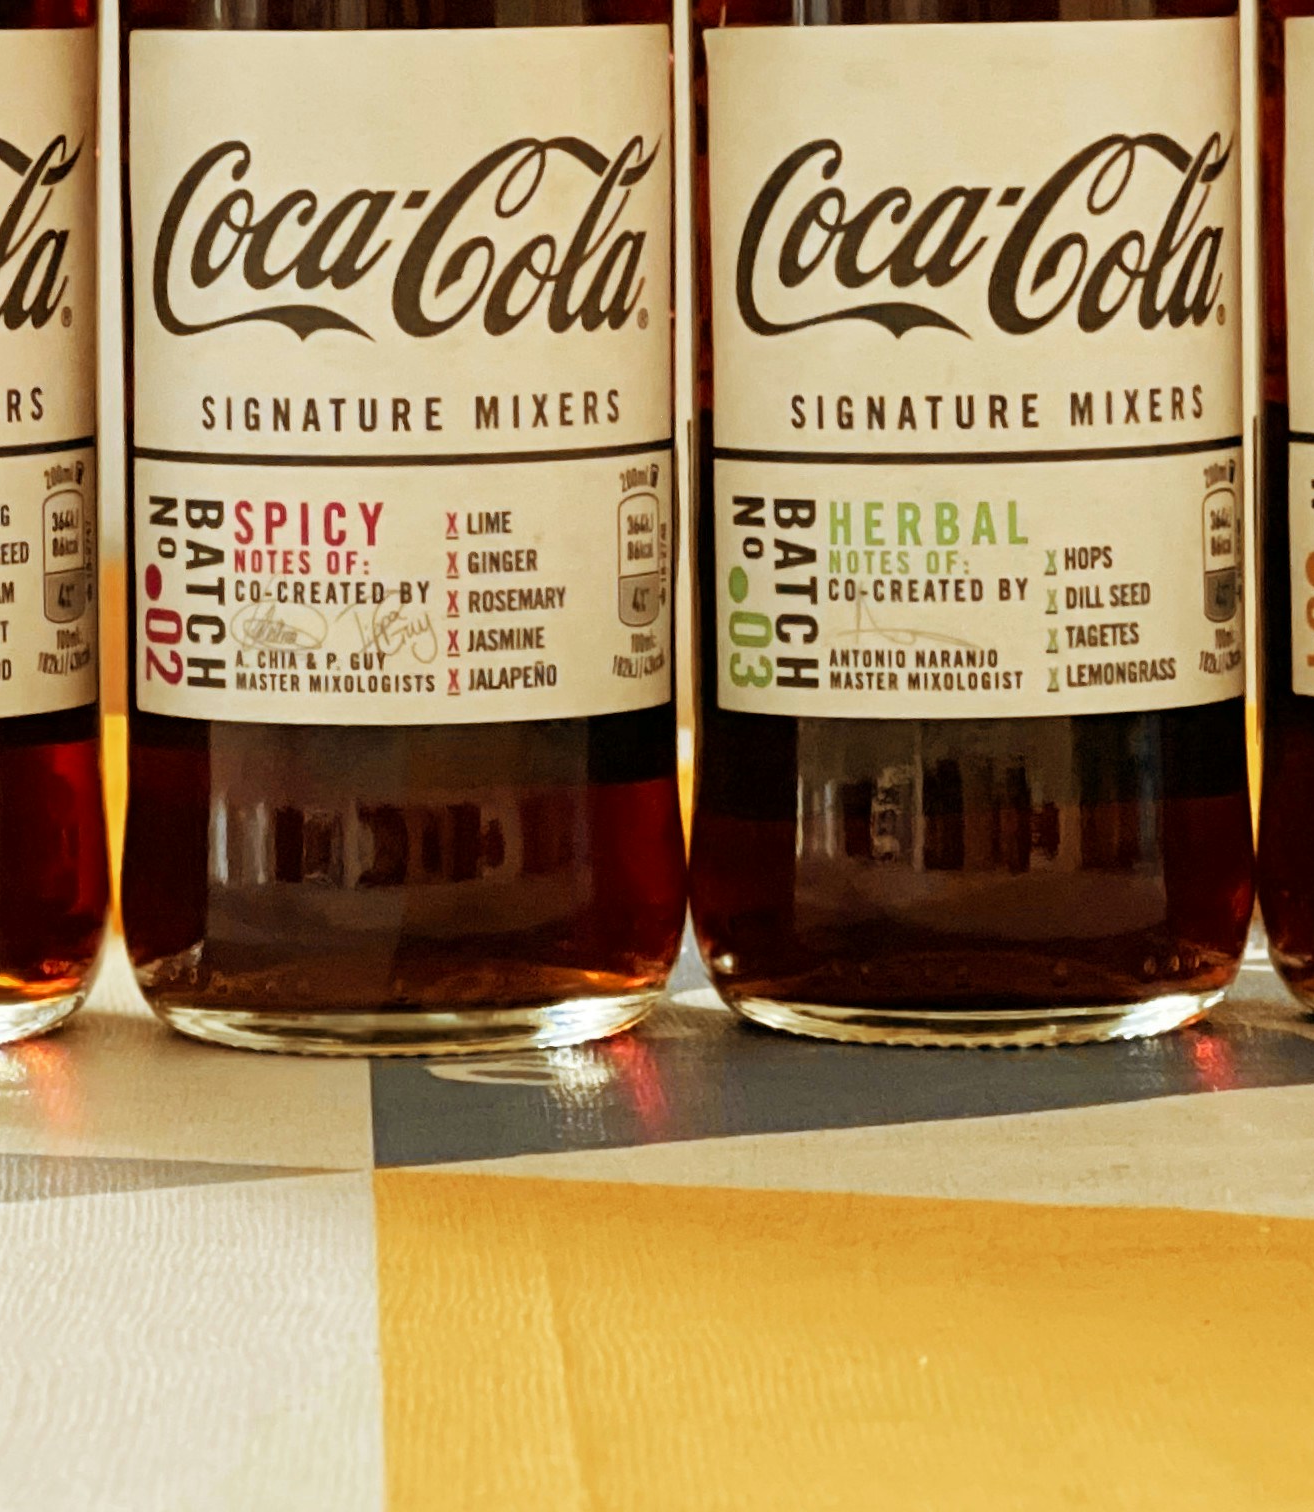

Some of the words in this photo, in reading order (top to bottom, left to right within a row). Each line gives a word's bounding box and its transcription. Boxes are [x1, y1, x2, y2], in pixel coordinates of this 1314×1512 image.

[153, 133, 663, 343] Coca-Cola
[736, 129, 1236, 340] Coca-Cola
[201, 395, 444, 432] SIGNATURE
[474, 389, 620, 430] MIXERS
[791, 392, 1039, 431] SIGNATURE
[1070, 384, 1204, 426] MIXERS
[234, 500, 384, 547] SPICY
[467, 511, 512, 535] LIME
[829, 500, 1029, 546] HERBAL
[234, 549, 311, 575] NOTES
[326, 550, 370, 575] OF:
[468, 549, 538, 575] GINGER
[828, 550, 910, 575] NOTES
[926, 550, 970, 575] OF:
[1064, 545, 1113, 571] HOPS
[185, 498, 226, 690] BATCH
[234, 579, 384, 605] CO-CREATED
[400, 580, 430, 605] BY
[468, 586, 566, 614] ROSEMARY
[773, 498, 819, 689] BATCH
[828, 578, 984, 603] CO-CREATED
[998, 577, 1029, 602] BY
[1065, 585, 1104, 610] DILL
[1109, 582, 1150, 607] SEED
[145, 607, 184, 686] 02
[467, 626, 546, 652] JASMINE
[728, 609, 774, 689] 03
[1065, 622, 1139, 648] TAGETES
[257, 650, 297, 670] CHIA
[350, 652, 387, 671] GUY
[829, 648, 906, 668] ANTONIO
[915, 649, 999, 669] NARANJO
[1066, 657, 1176, 688] LEMONGRASS
[236, 672, 300, 692] MASTER
[310, 674, 436, 693] MIXOLOGISTS
[468, 660, 558, 692] JALAPEÑO
[830, 671, 899, 691] MASTER
[907, 671, 1023, 691] MIXOLOGIST
